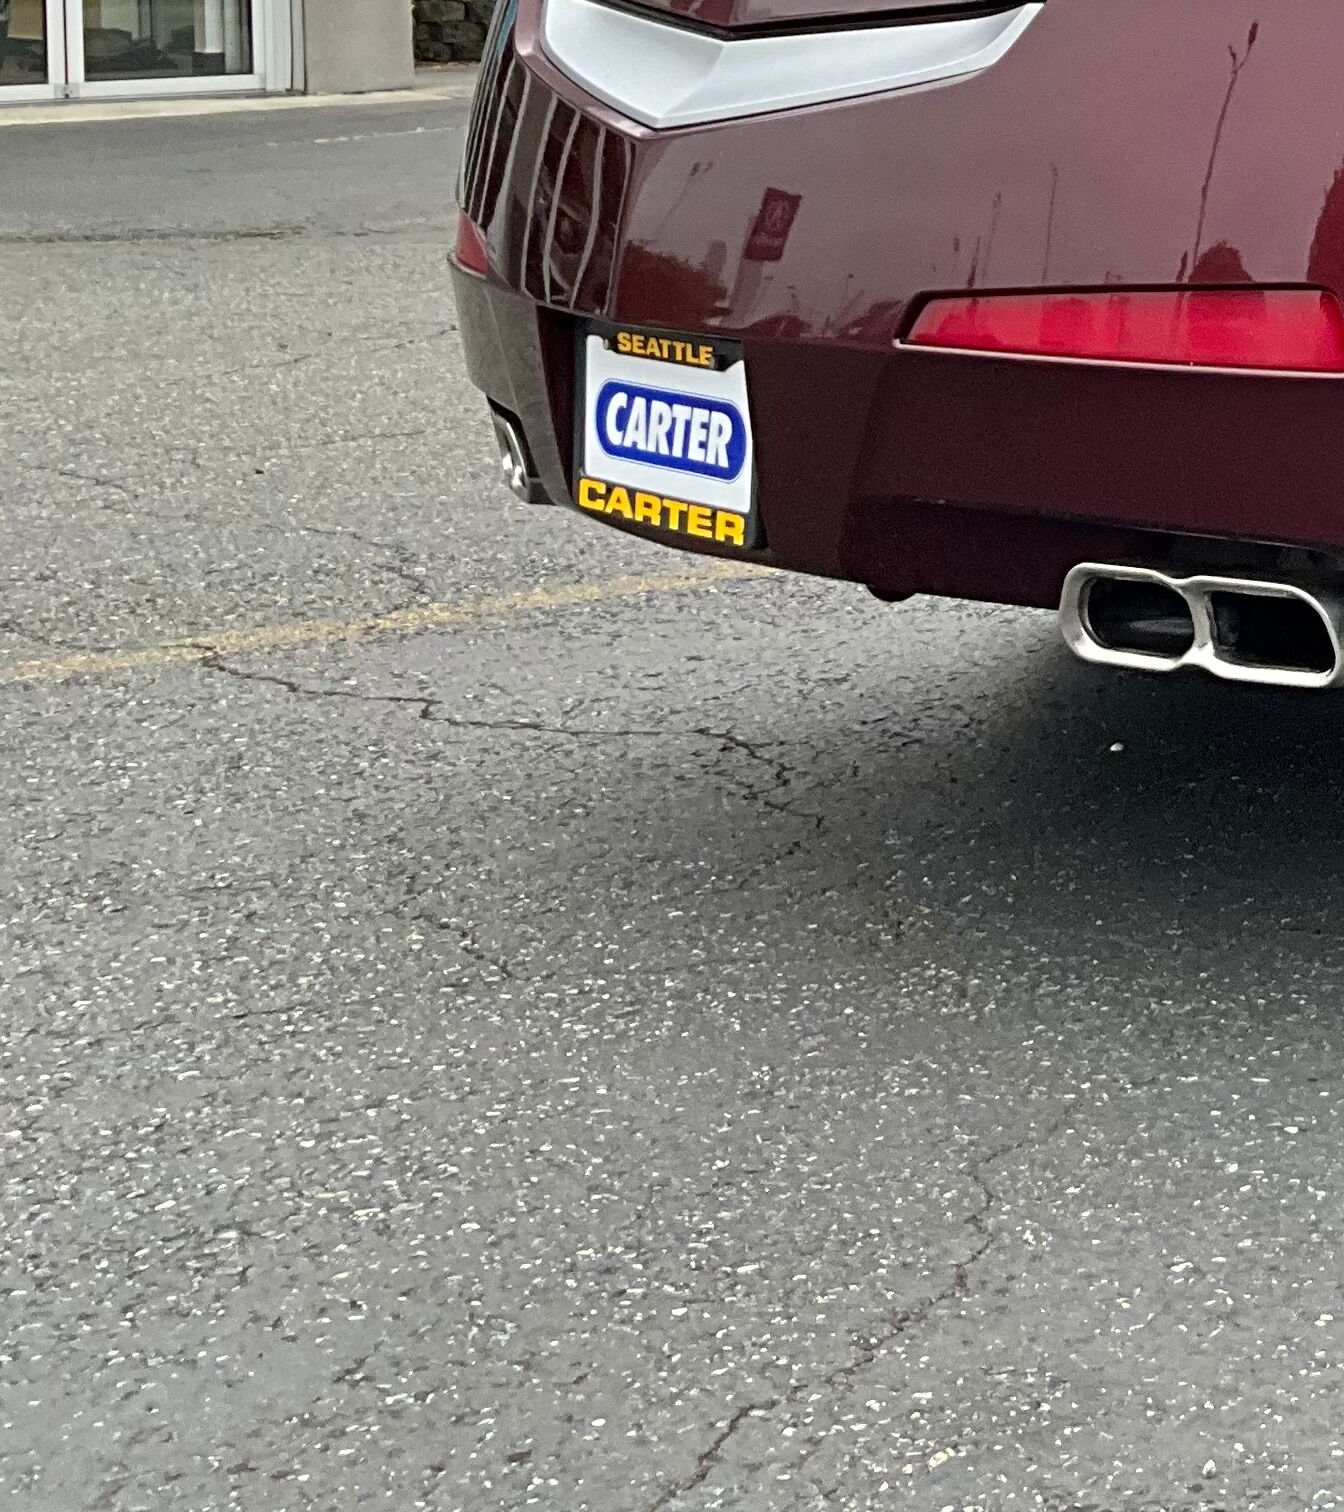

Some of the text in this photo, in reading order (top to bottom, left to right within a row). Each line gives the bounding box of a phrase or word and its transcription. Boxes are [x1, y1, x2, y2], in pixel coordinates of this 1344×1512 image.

[616, 331, 714, 366] SEATTLE
[605, 391, 733, 468] CARTER
[578, 477, 745, 546] CARTER
